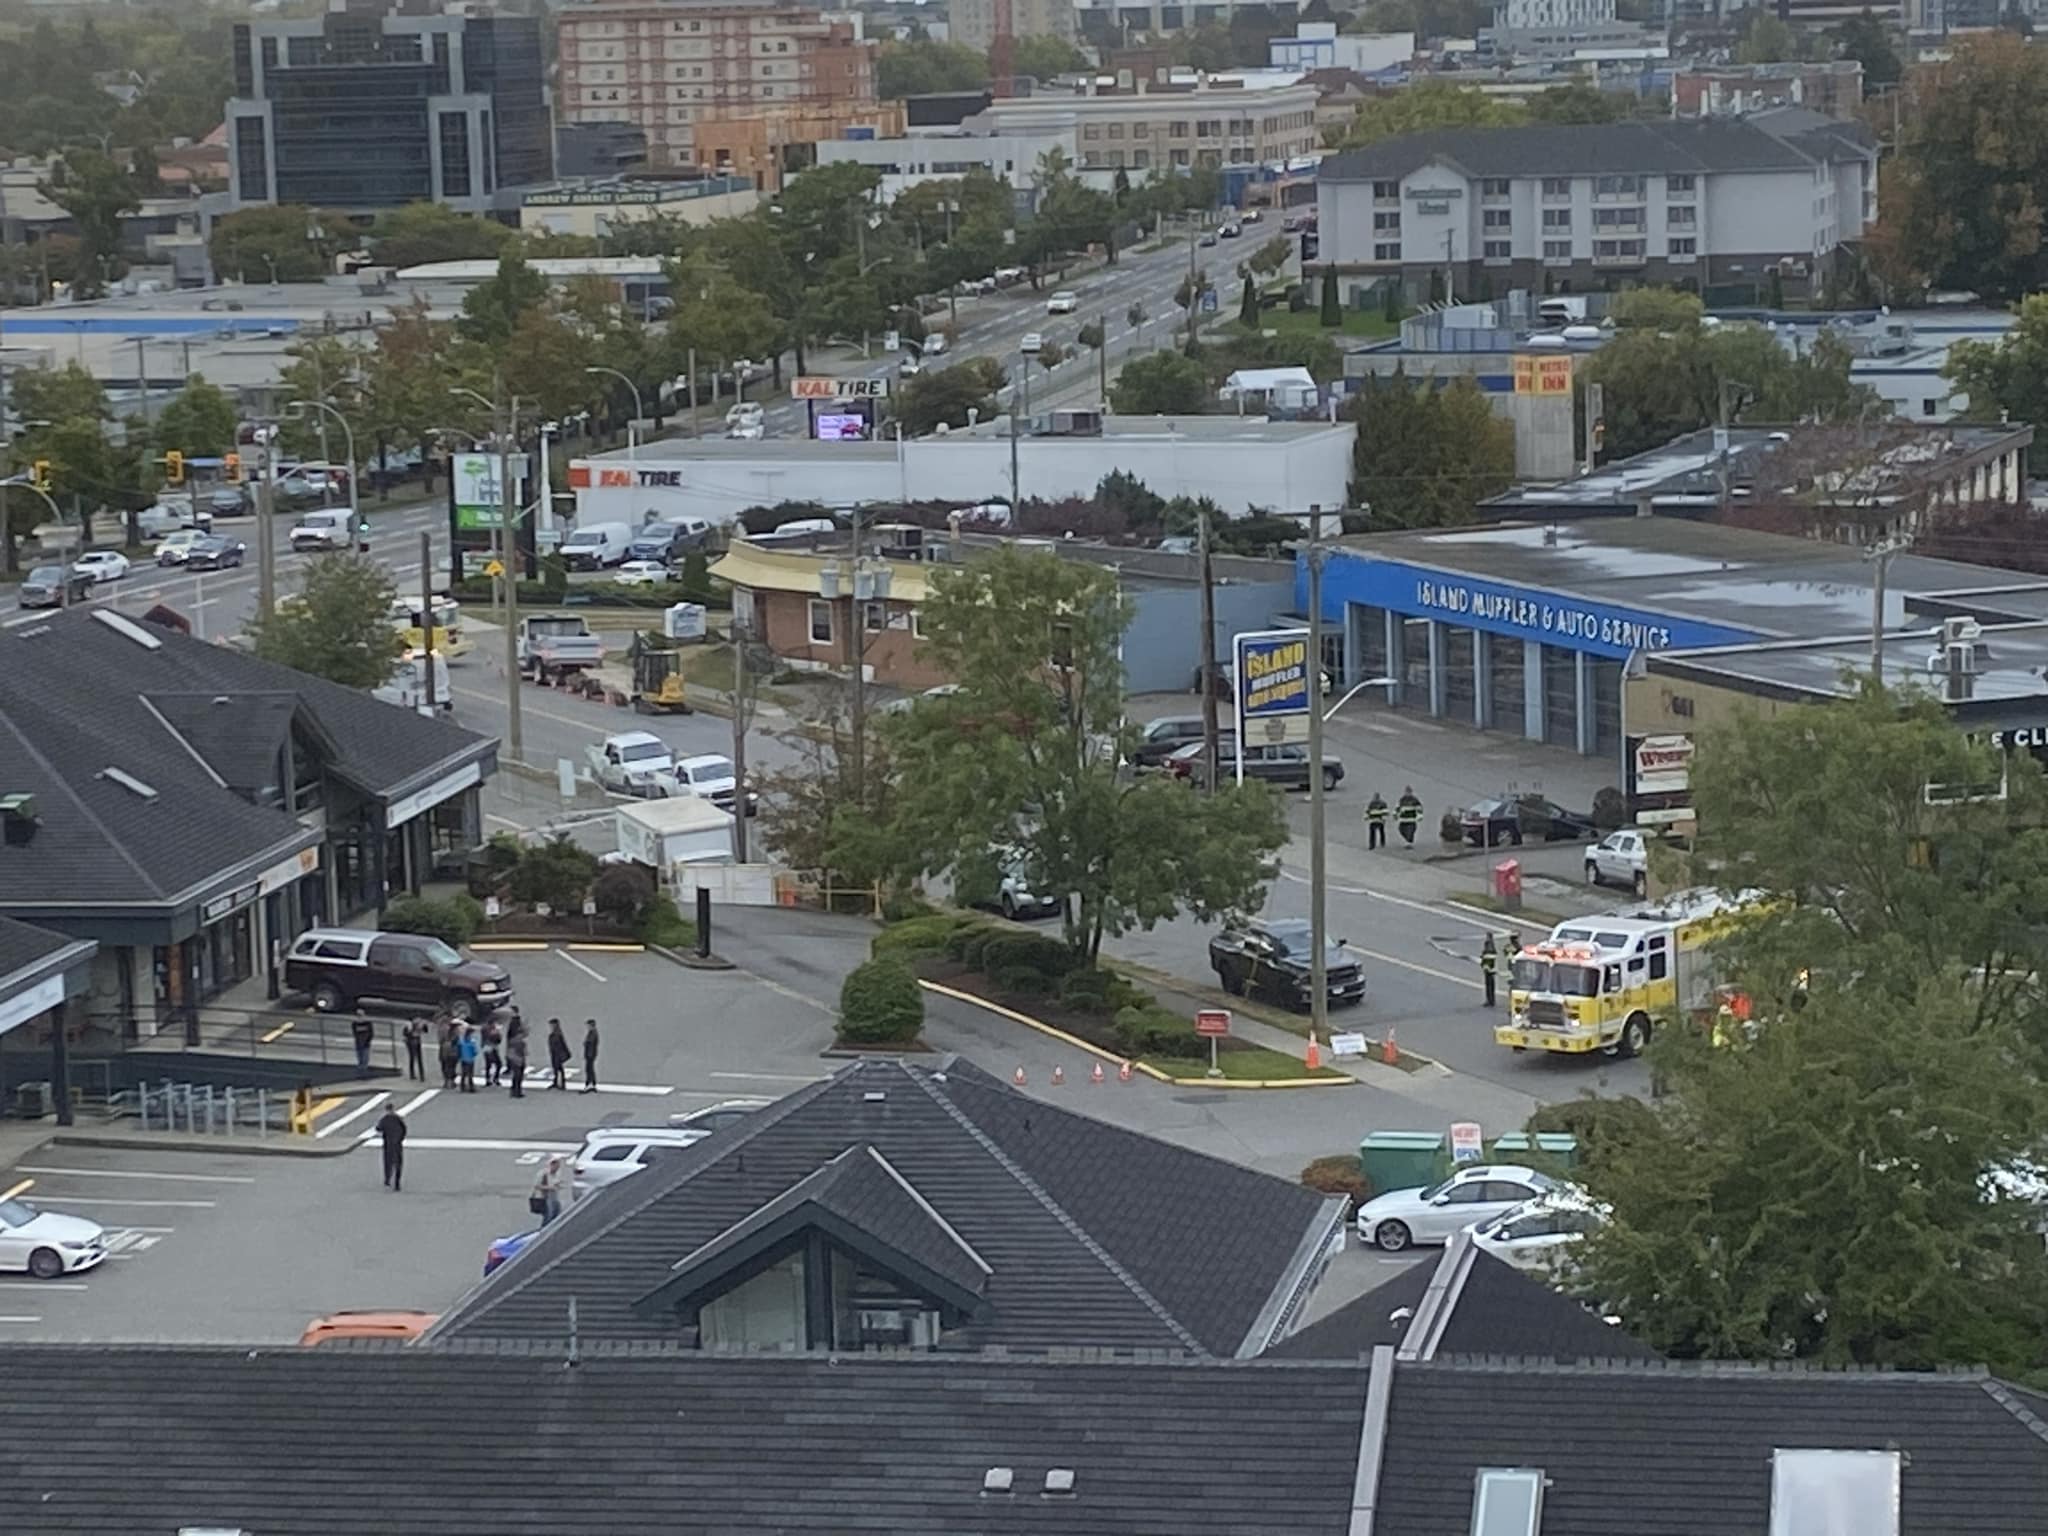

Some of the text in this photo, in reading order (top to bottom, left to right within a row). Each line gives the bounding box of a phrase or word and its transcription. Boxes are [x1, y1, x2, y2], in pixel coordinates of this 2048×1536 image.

[797, 380, 881, 396] KAL TIRE
[637, 470, 681, 487] TIRE
[1416, 579, 1670, 650] ISLAND MUFFLER & AUTO SERVICE
[1247, 642, 1305, 680] ISLAND
